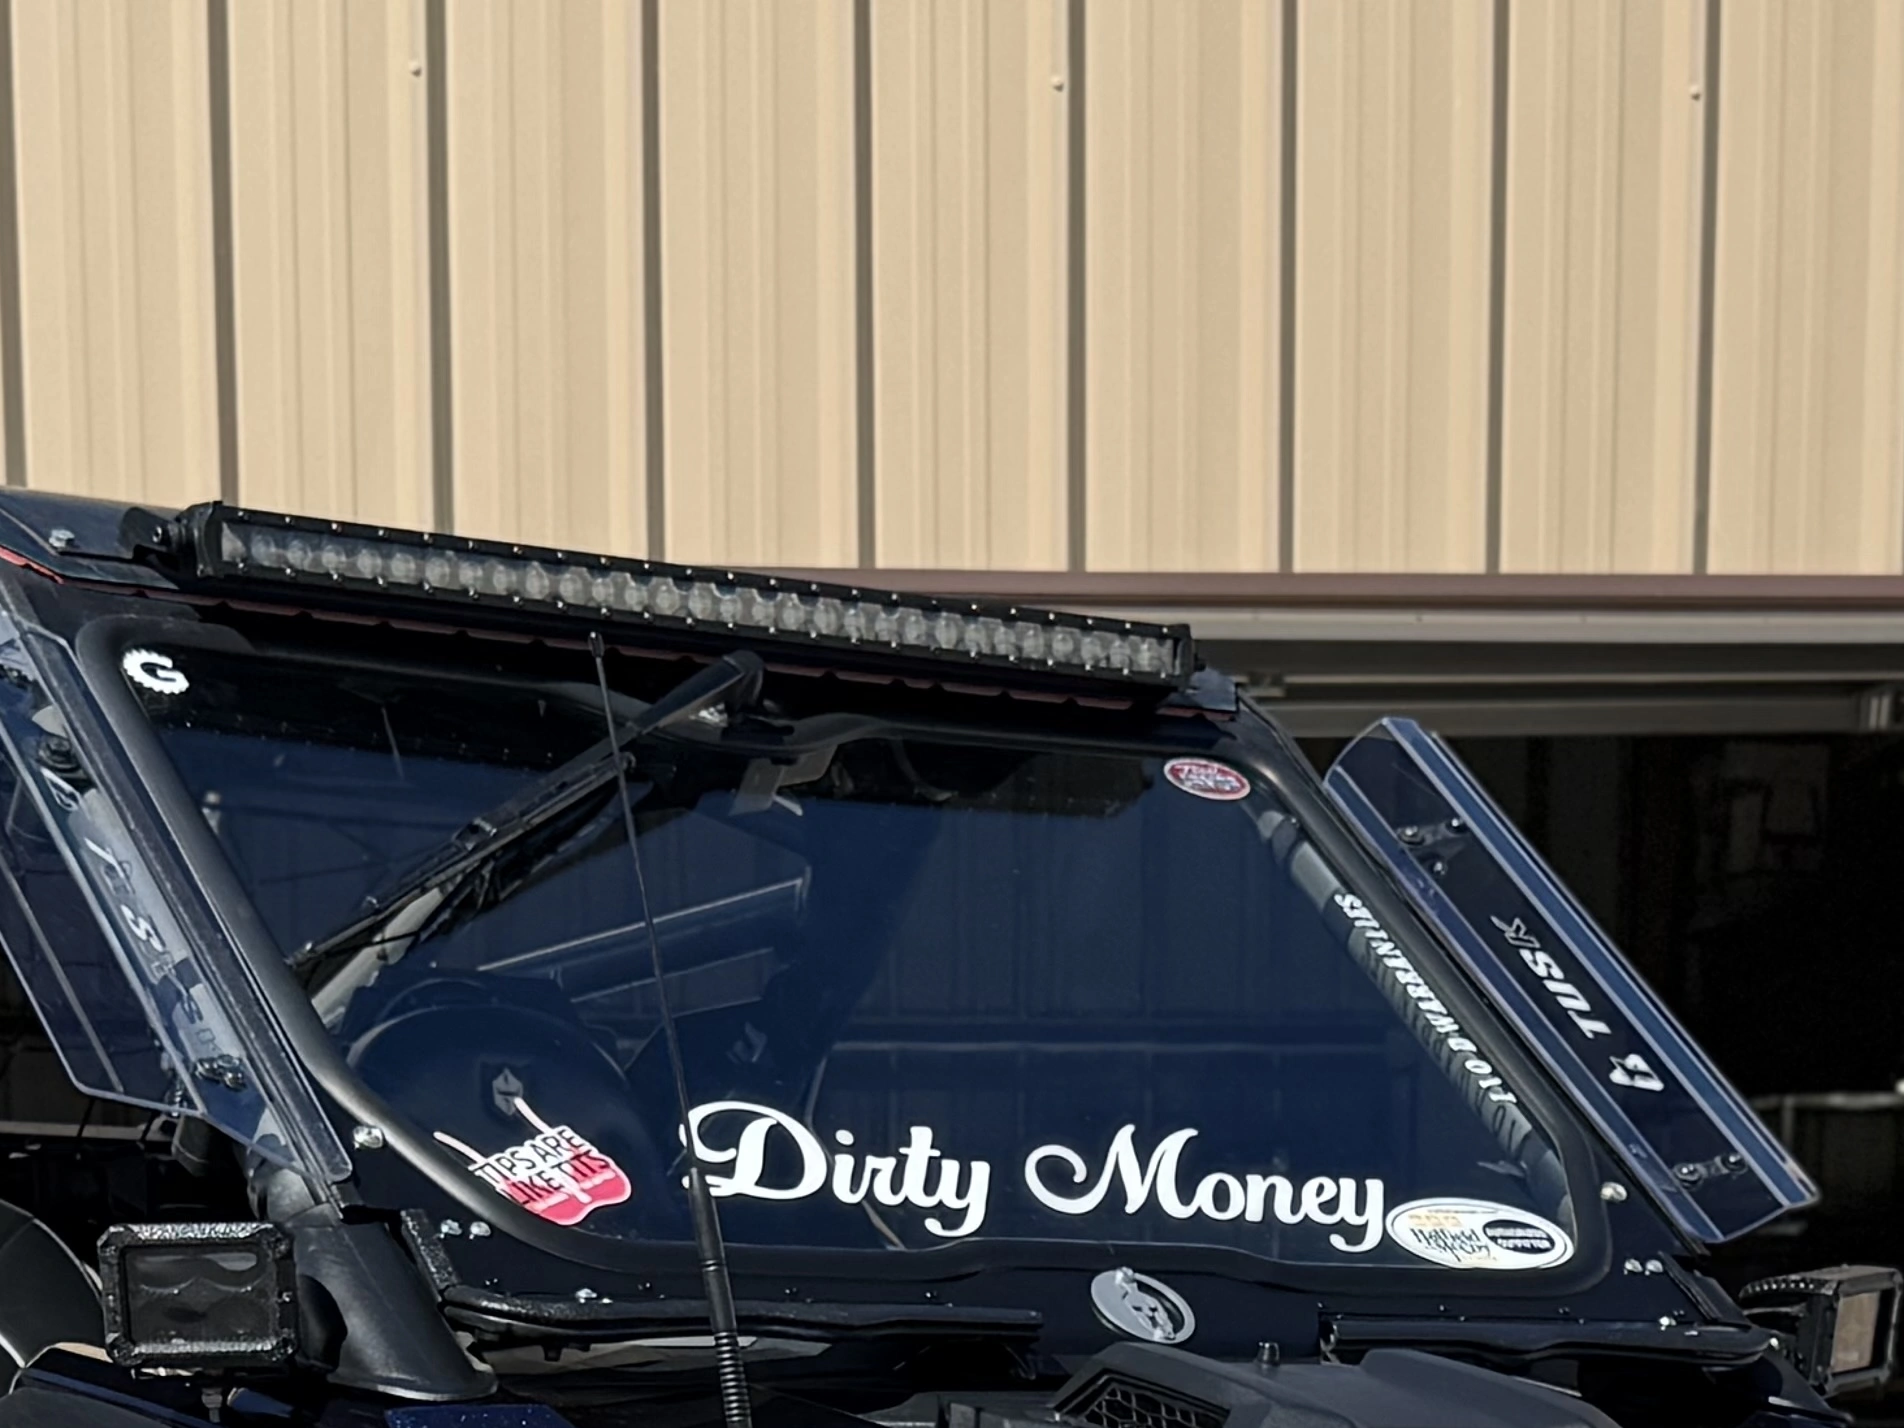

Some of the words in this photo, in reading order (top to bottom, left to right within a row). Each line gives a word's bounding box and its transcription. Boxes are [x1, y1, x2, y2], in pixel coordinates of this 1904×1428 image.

[1490, 914, 1612, 1040] TUSK
[529, 1128, 585, 1164] ARE
[680, 1100, 989, 1237] Dirty
[1024, 1123, 1383, 1252] Money
